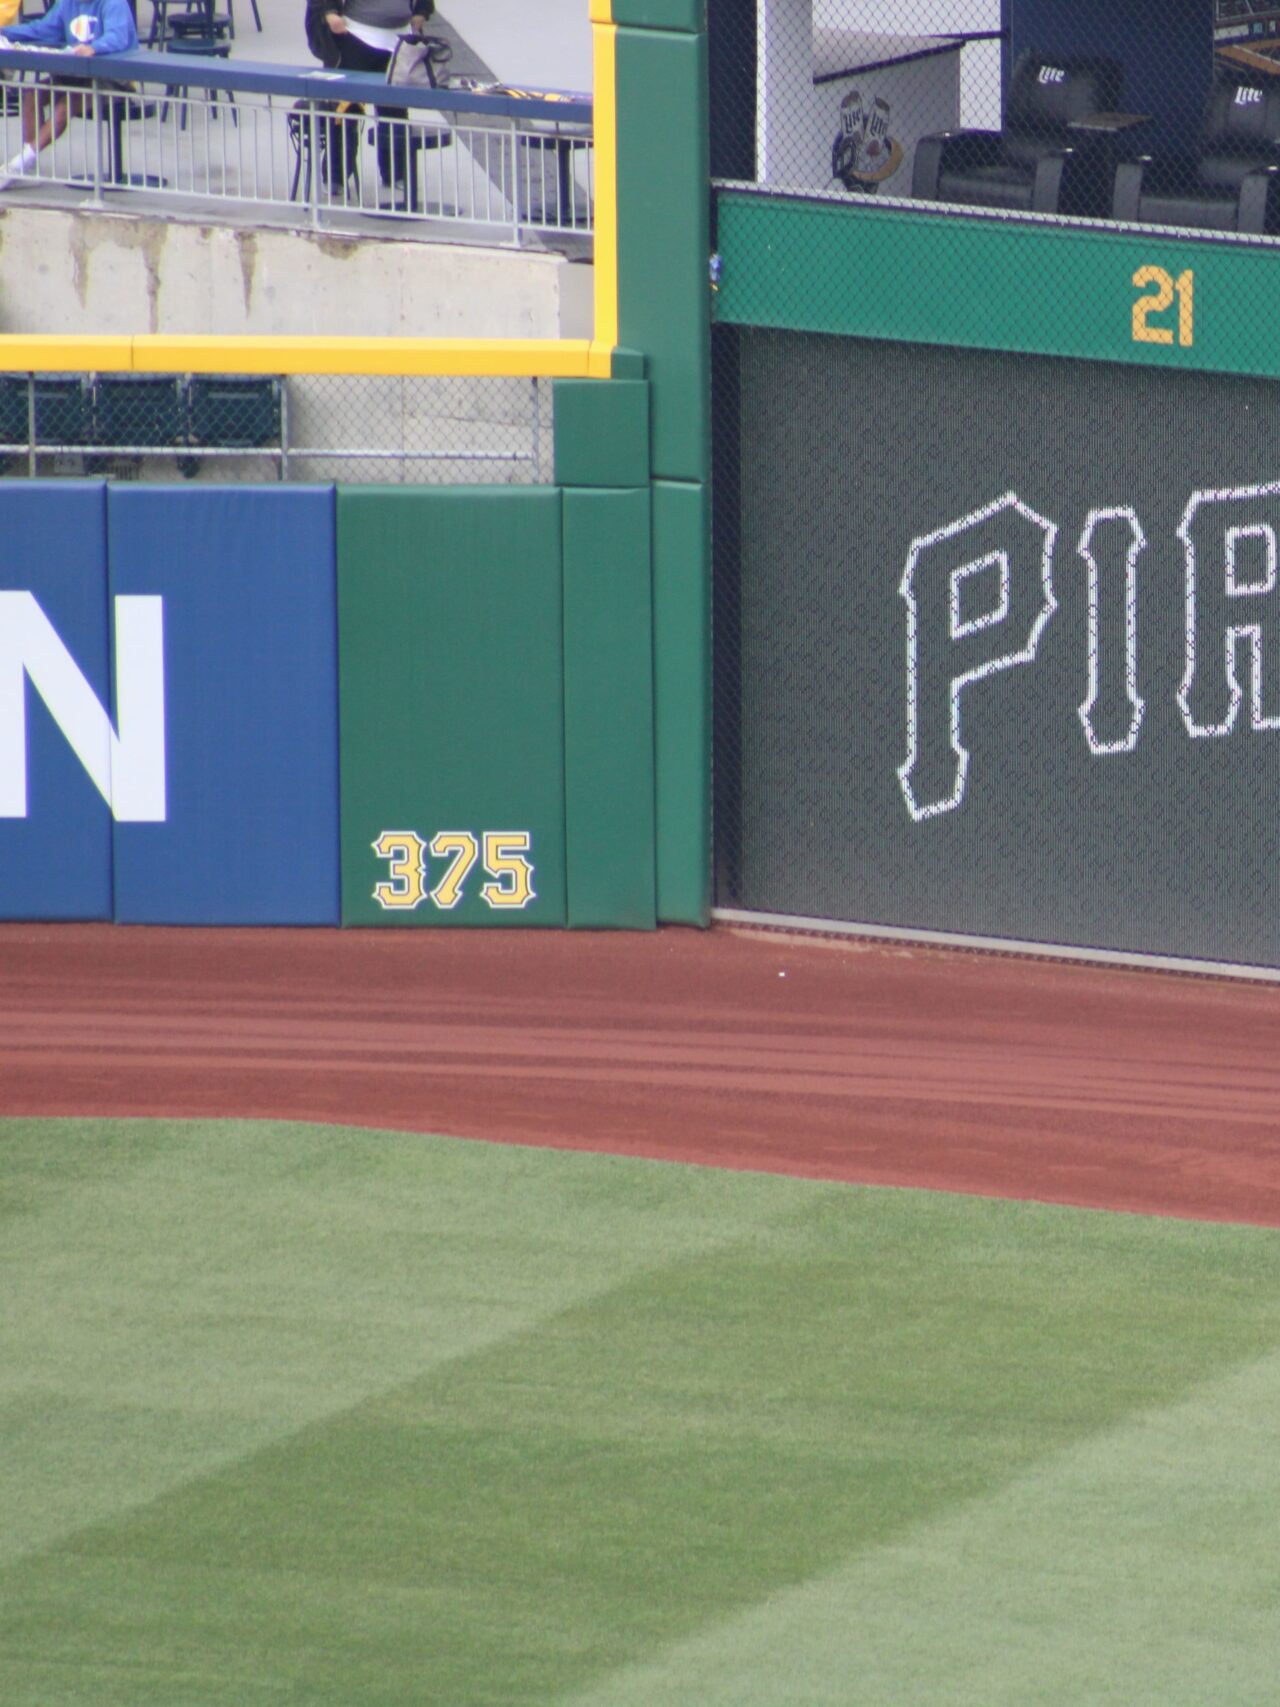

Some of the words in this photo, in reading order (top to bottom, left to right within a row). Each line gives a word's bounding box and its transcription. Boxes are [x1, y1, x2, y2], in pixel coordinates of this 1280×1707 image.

[1037, 65, 1065, 84] Lite
[1235, 86, 1263, 105] Lite
[1132, 265, 1193, 346] 21
[371, 831, 536, 910] 375
